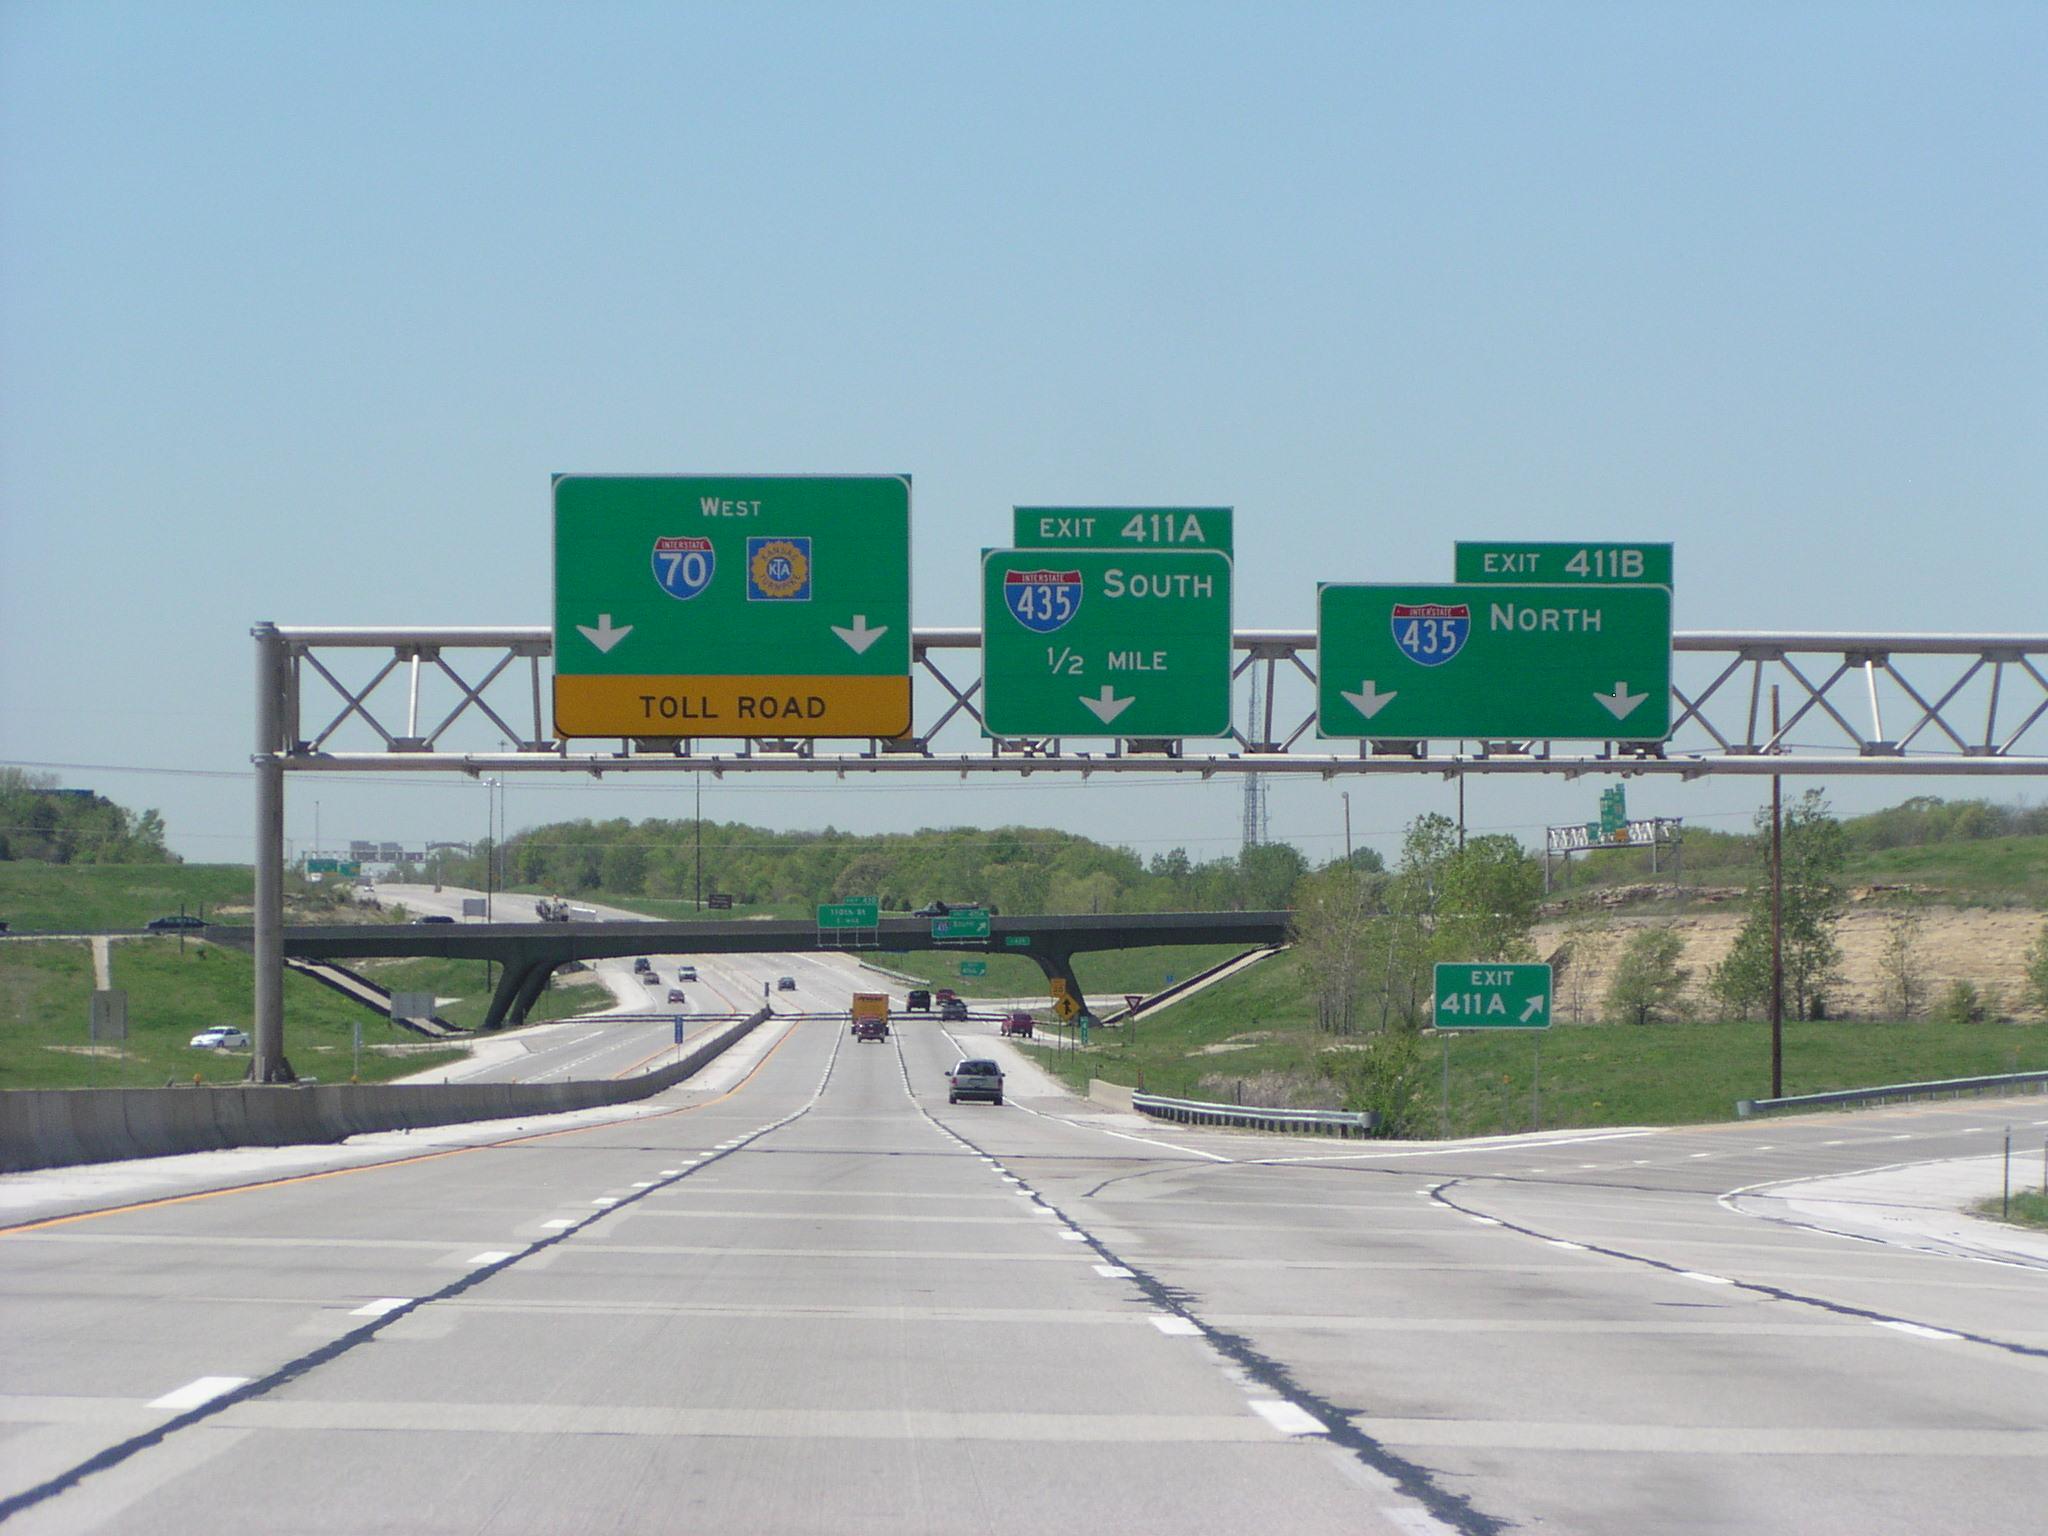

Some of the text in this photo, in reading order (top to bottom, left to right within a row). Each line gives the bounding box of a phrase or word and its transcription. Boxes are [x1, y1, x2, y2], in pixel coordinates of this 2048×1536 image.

[700, 497, 761, 516] WEST
[1039, 514, 1205, 543] EXIT 411A
[661, 540, 705, 549] INTERSTATE
[659, 552, 706, 587] 70
[768, 558, 791, 580] KTA
[1484, 550, 1645, 578] EXIT 411B
[1021, 573, 1065, 583] INTERSTATE
[1103, 568, 1213, 598] SOUTH
[1017, 586, 1071, 620] 435
[1409, 607, 1452, 616] INTERSTATE
[1490, 603, 1602, 632] NORTH
[1402, 619, 1456, 654] 435
[1047, 647, 1168, 675] 1/2 MILE
[639, 696, 826, 719] TOLL ROAD
[1471, 970, 1515, 986] EXIT
[1441, 992, 1507, 1015] 411A
